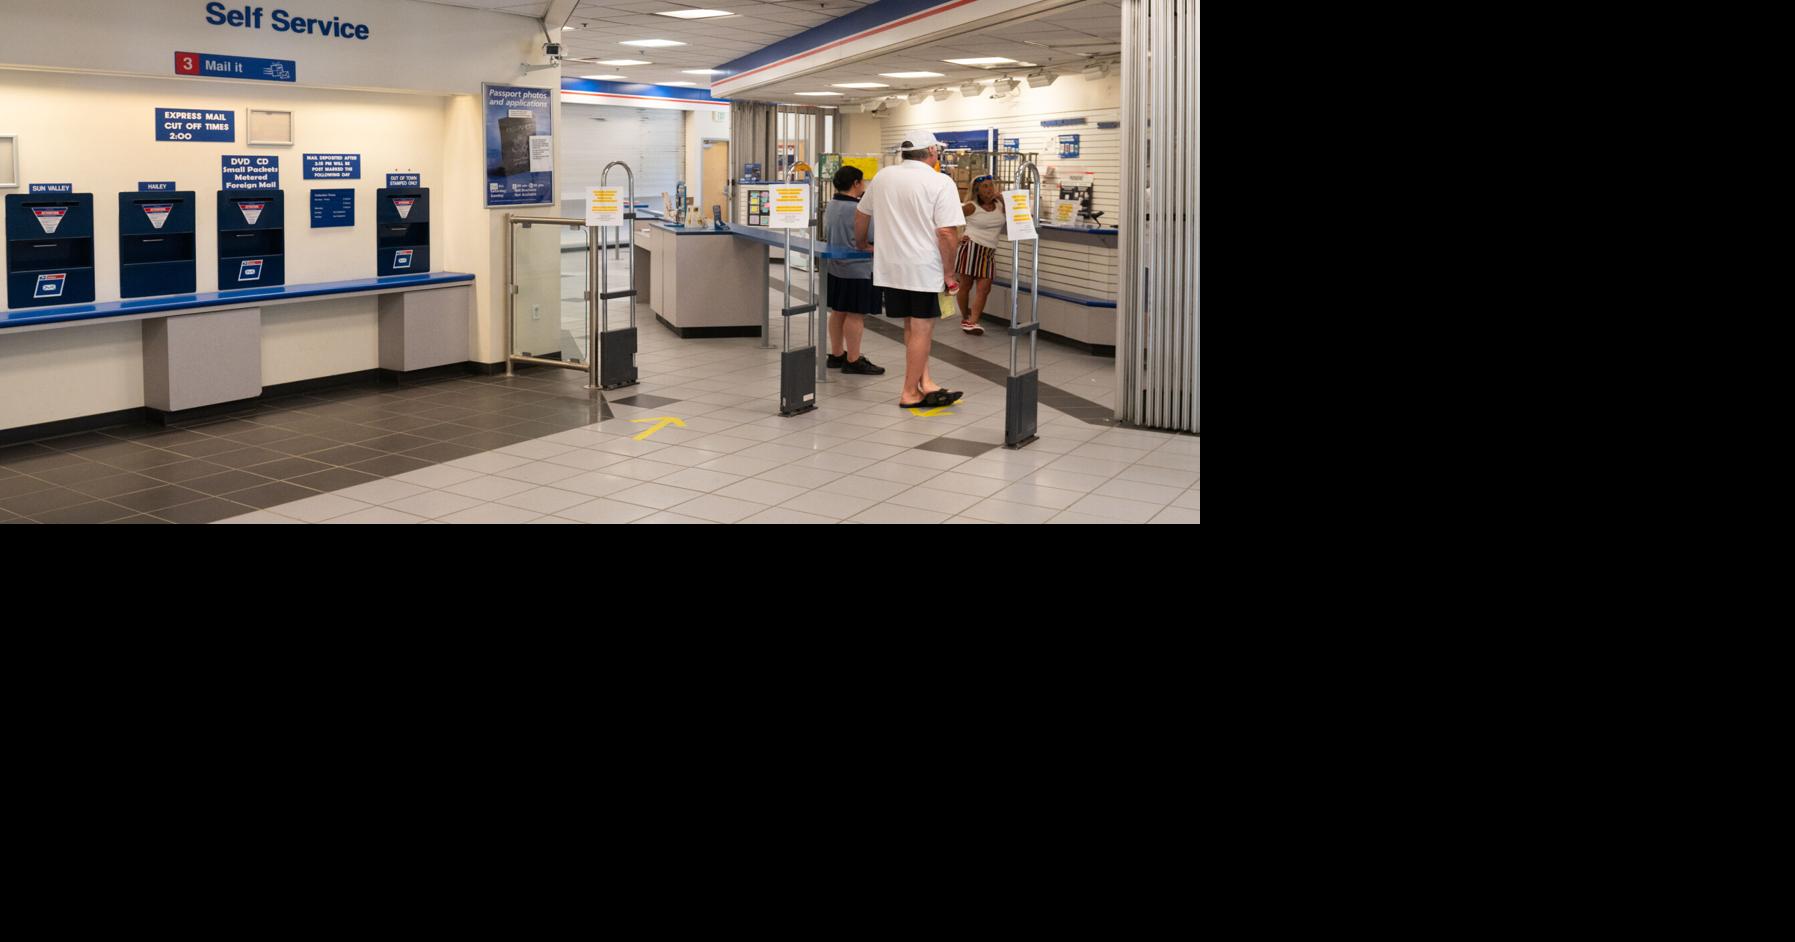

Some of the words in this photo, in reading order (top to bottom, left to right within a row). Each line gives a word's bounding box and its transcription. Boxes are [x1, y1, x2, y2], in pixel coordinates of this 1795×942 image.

[206, 2, 263, 29] Self
[271, 9, 369, 40] Service
[183, 57, 193, 70] 3
[205, 60, 231, 73] Mail
[235, 62, 243, 73] it
[489, 89, 521, 98] Passport
[523, 91, 547, 100] photos
[506, 100, 547, 108] applications
[164, 111, 202, 120] EXPRESS
[206, 113, 226, 121] MAIL
[164, 122, 182, 130] CUT
[205, 123, 229, 131] TIMES
[169, 132, 192, 140] 2:00
